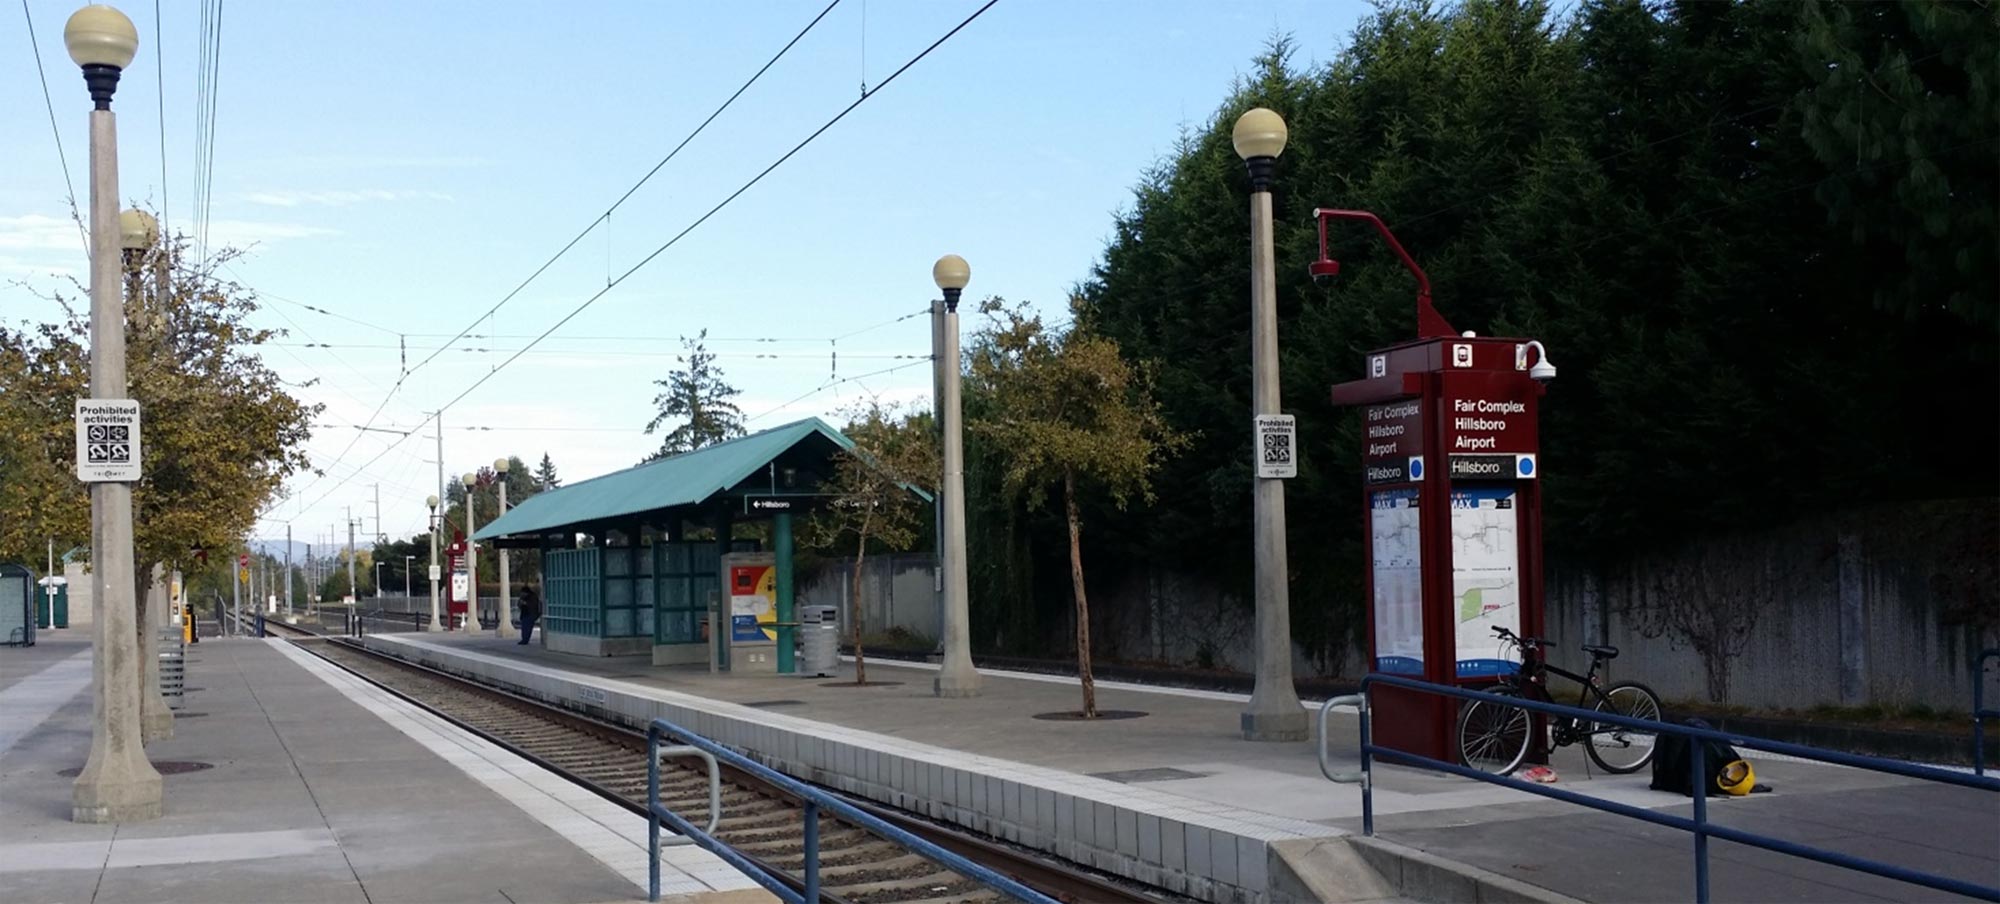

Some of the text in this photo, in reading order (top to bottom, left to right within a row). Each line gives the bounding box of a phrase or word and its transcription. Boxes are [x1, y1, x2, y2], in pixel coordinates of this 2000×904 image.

[80, 406, 137, 415] Prohibited
[1368, 404, 1420, 420] Fair Complex
[1455, 400, 1525, 414] Fair Complex
[83, 415, 133, 423] activities
[1455, 417, 1506, 430] Hillsboro
[1369, 424, 1405, 438] Hillsboro
[1369, 442, 1397, 456] Airport
[1455, 435, 1496, 451] Airport
[1367, 466, 1402, 480] Hillsboro
[1452, 460, 1500, 473] Hillsboro
[761, 500, 790, 509] Hillsboro
[1374, 500, 1392, 510] MAX
